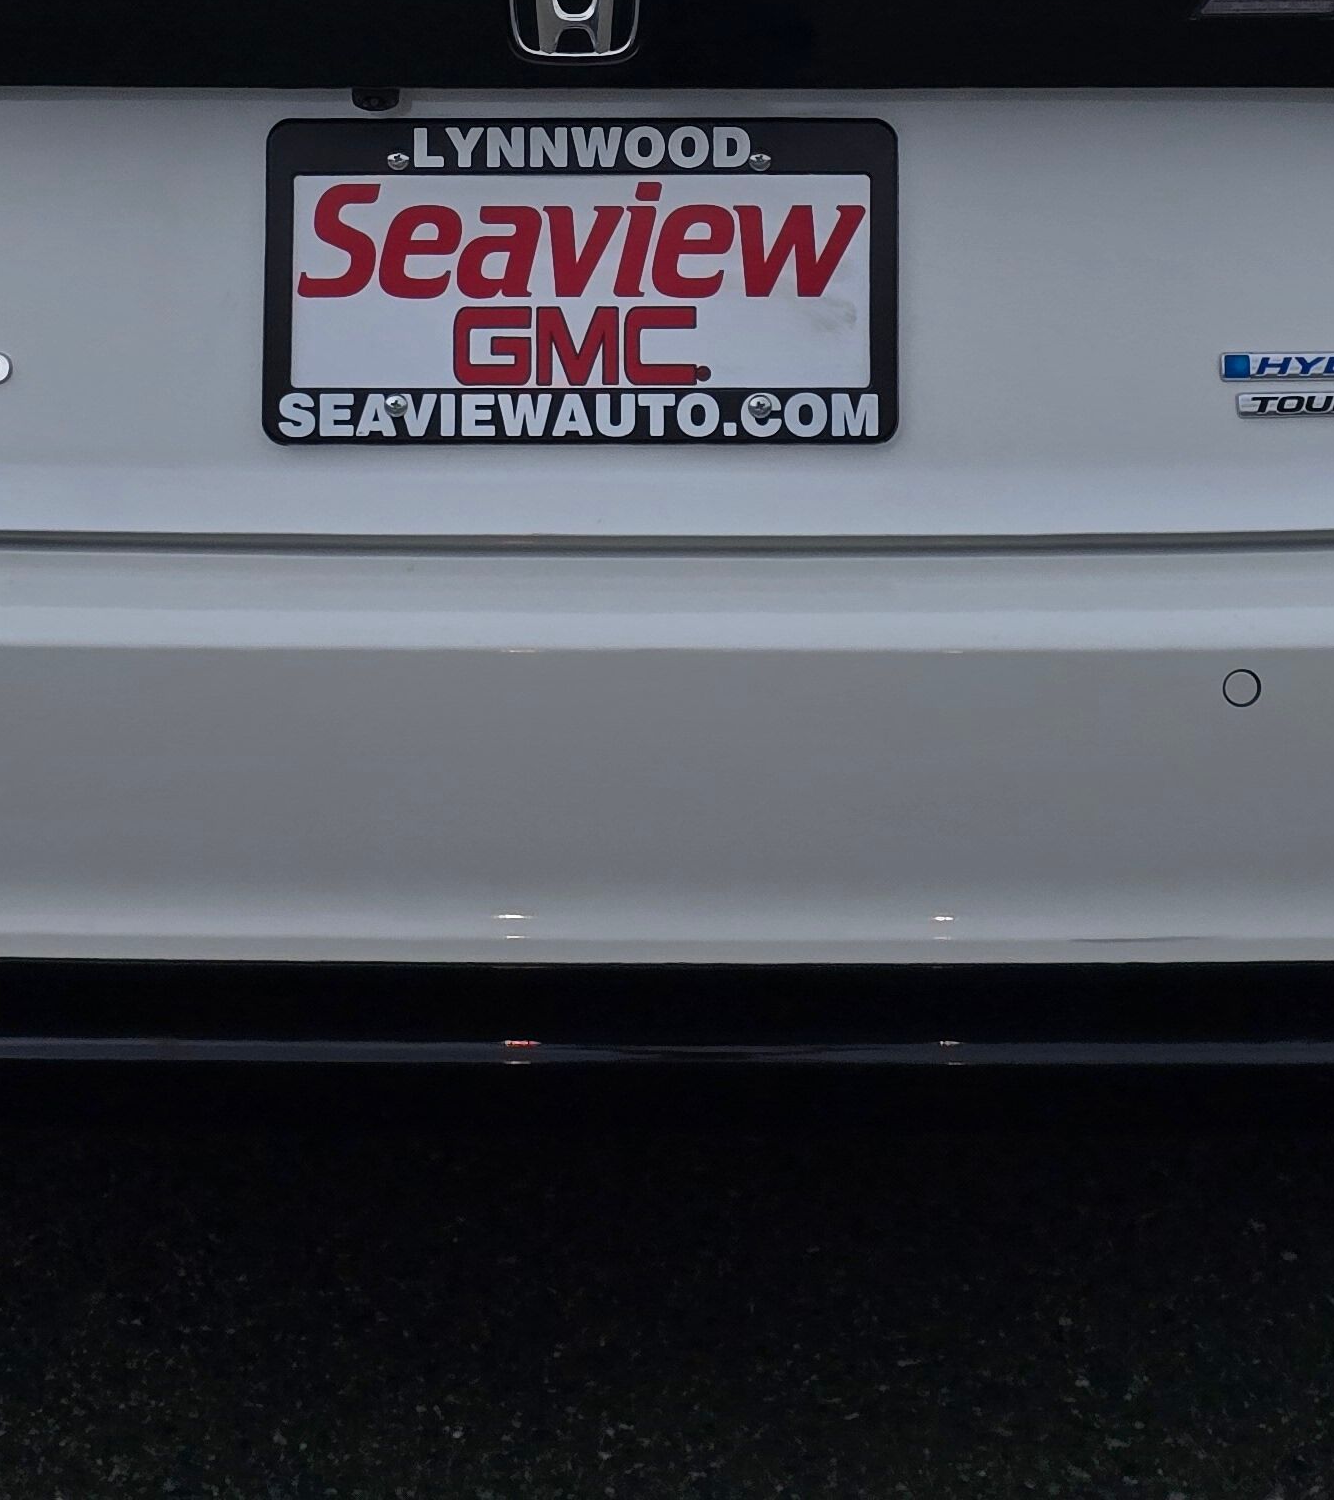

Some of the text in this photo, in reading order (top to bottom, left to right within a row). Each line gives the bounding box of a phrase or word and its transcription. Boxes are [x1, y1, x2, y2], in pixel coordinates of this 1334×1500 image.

[412, 126, 751, 169] LYNNWOOD
[297, 181, 866, 299] Seaview
[453, 306, 698, 387] GMC
[278, 392, 880, 438] SEAVIEWAUTO.COM
